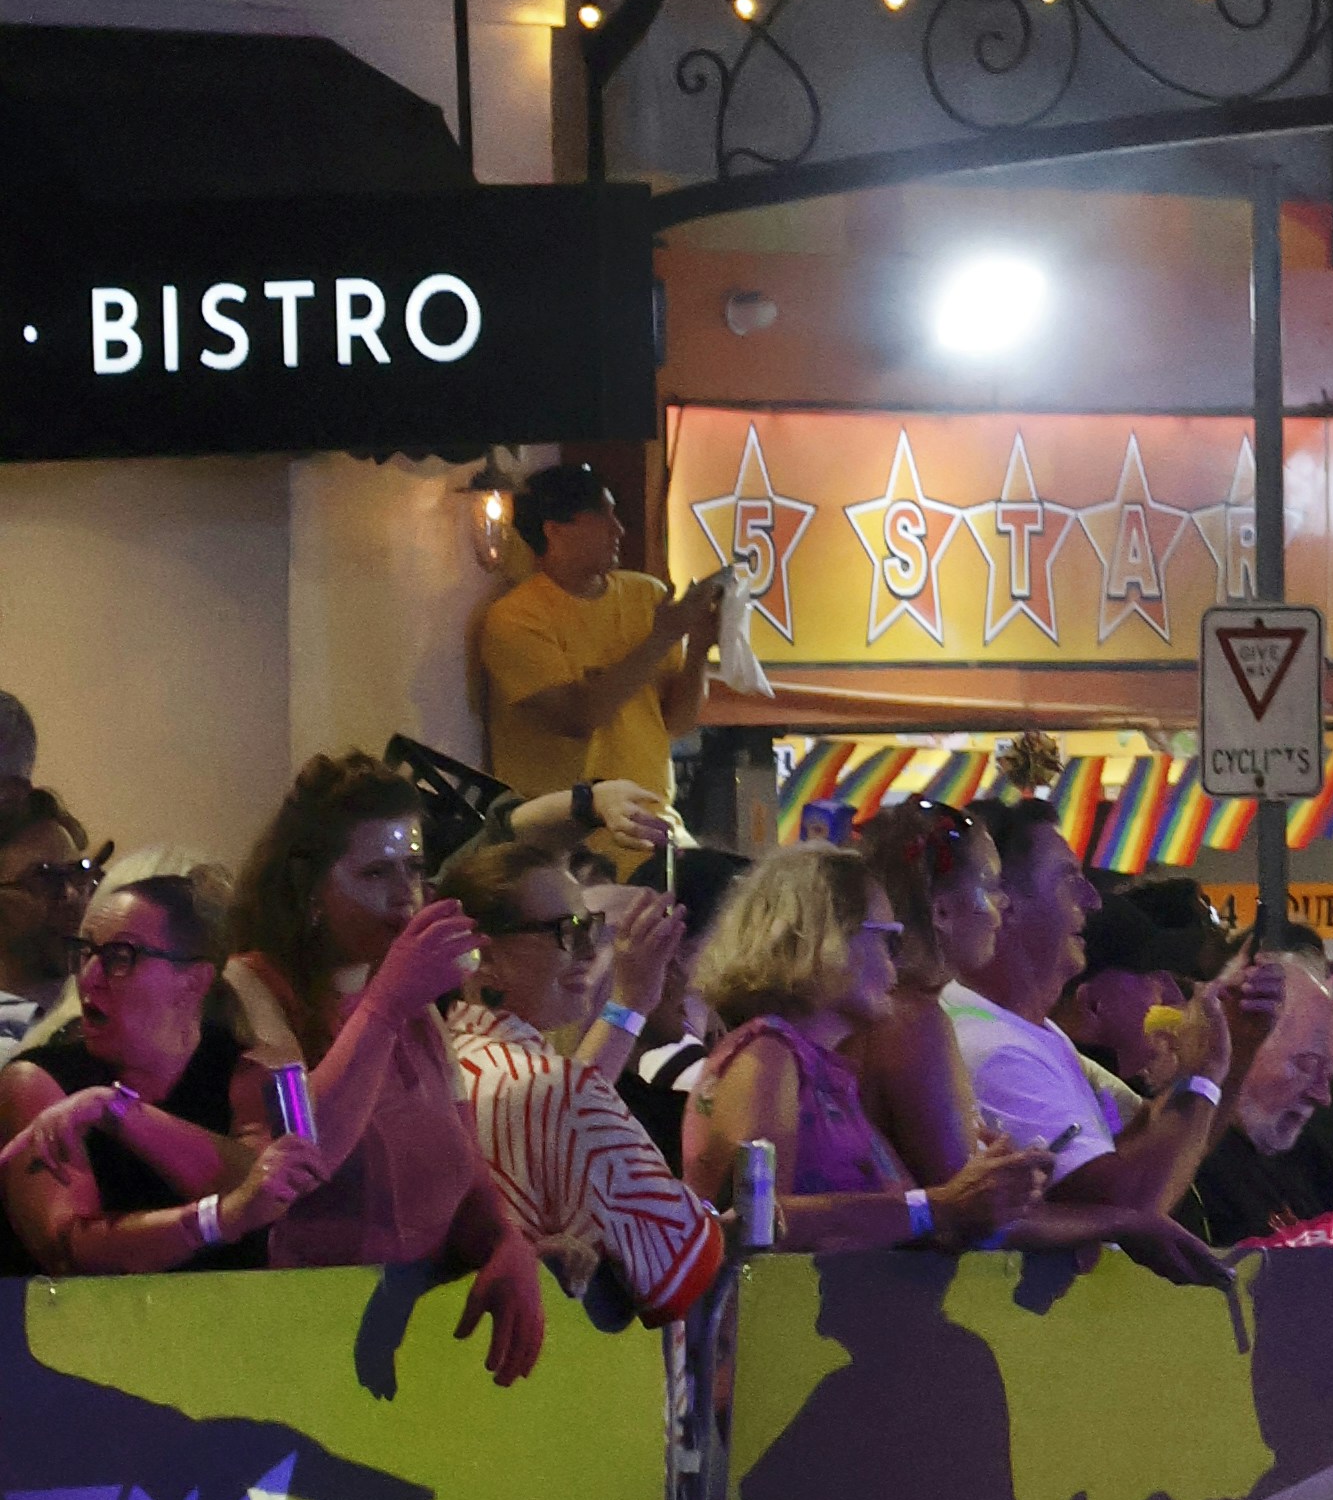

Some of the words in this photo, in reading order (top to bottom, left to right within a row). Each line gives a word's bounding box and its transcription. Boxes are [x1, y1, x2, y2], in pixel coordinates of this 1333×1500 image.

[91, 272, 482, 375] BISTRO
[733, 499, 776, 597] 5
[881, 499, 1258, 602] STAR
